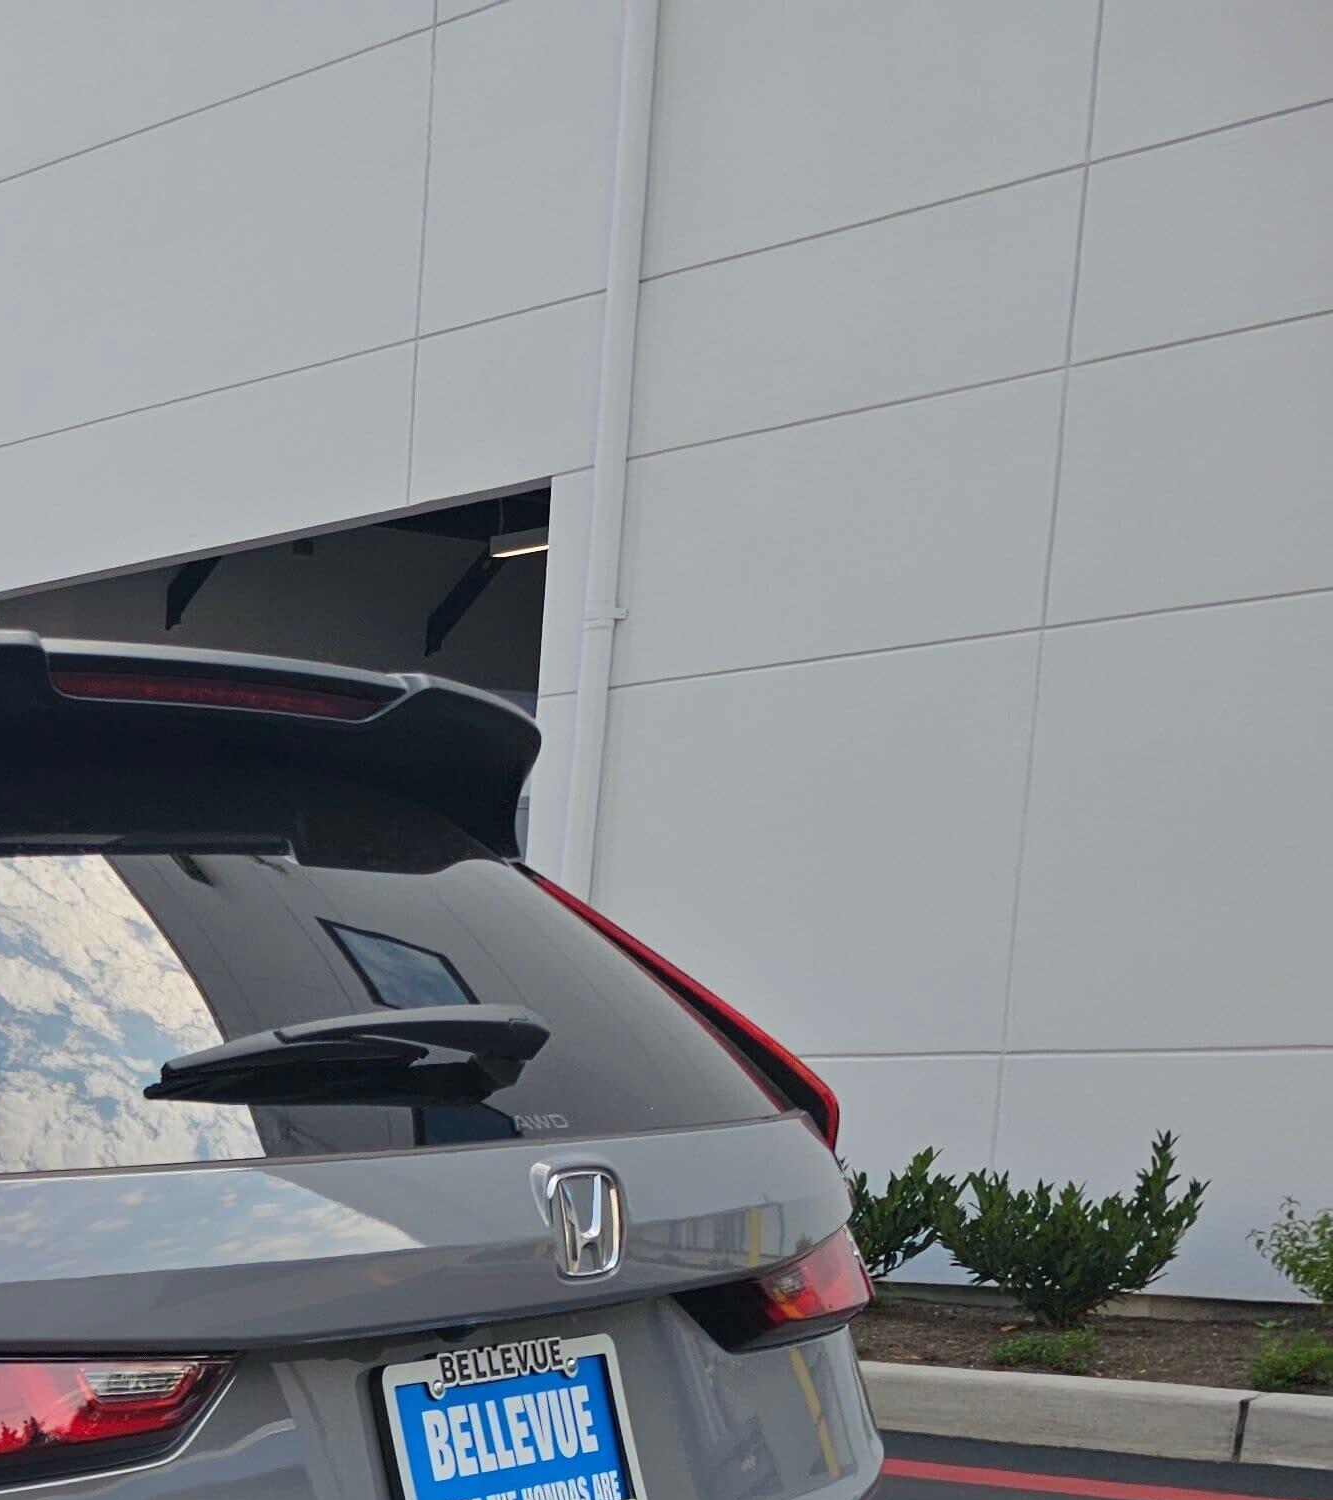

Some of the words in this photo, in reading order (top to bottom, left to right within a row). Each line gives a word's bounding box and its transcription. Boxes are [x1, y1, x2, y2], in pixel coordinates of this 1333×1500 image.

[514, 1113, 569, 1131] AWD
[440, 1339, 562, 1383] BELLEVUE
[422, 1386, 599, 1482] BELLEVUE
